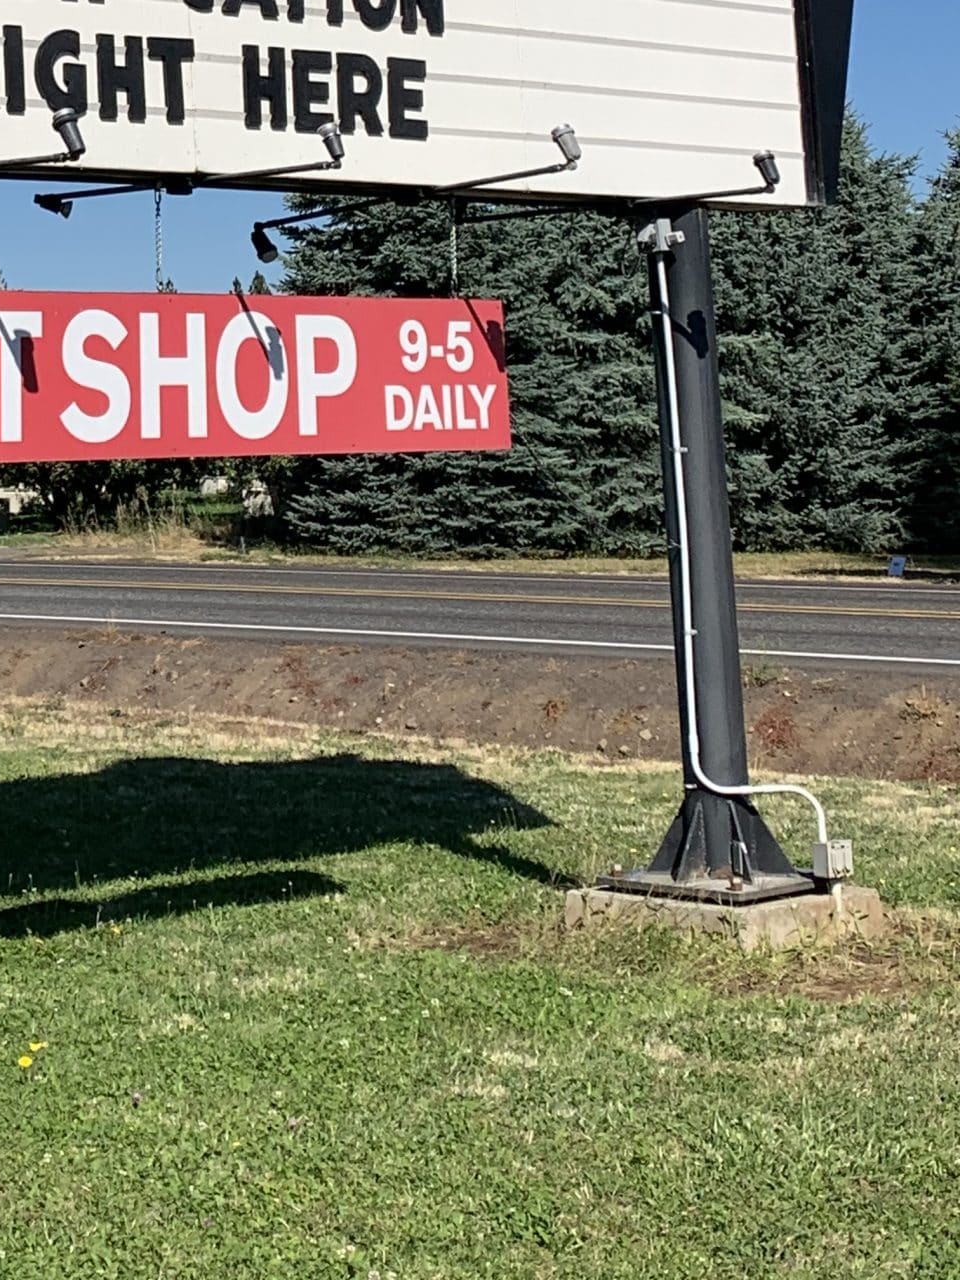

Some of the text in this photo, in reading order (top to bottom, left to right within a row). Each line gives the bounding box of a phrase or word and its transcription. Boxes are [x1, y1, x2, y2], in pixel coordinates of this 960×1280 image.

[241, 44, 429, 141] HERE
[59, 308, 357, 443] SHOP
[398, 320, 474, 374] 9-5
[384, 383, 497, 432] DAILY
